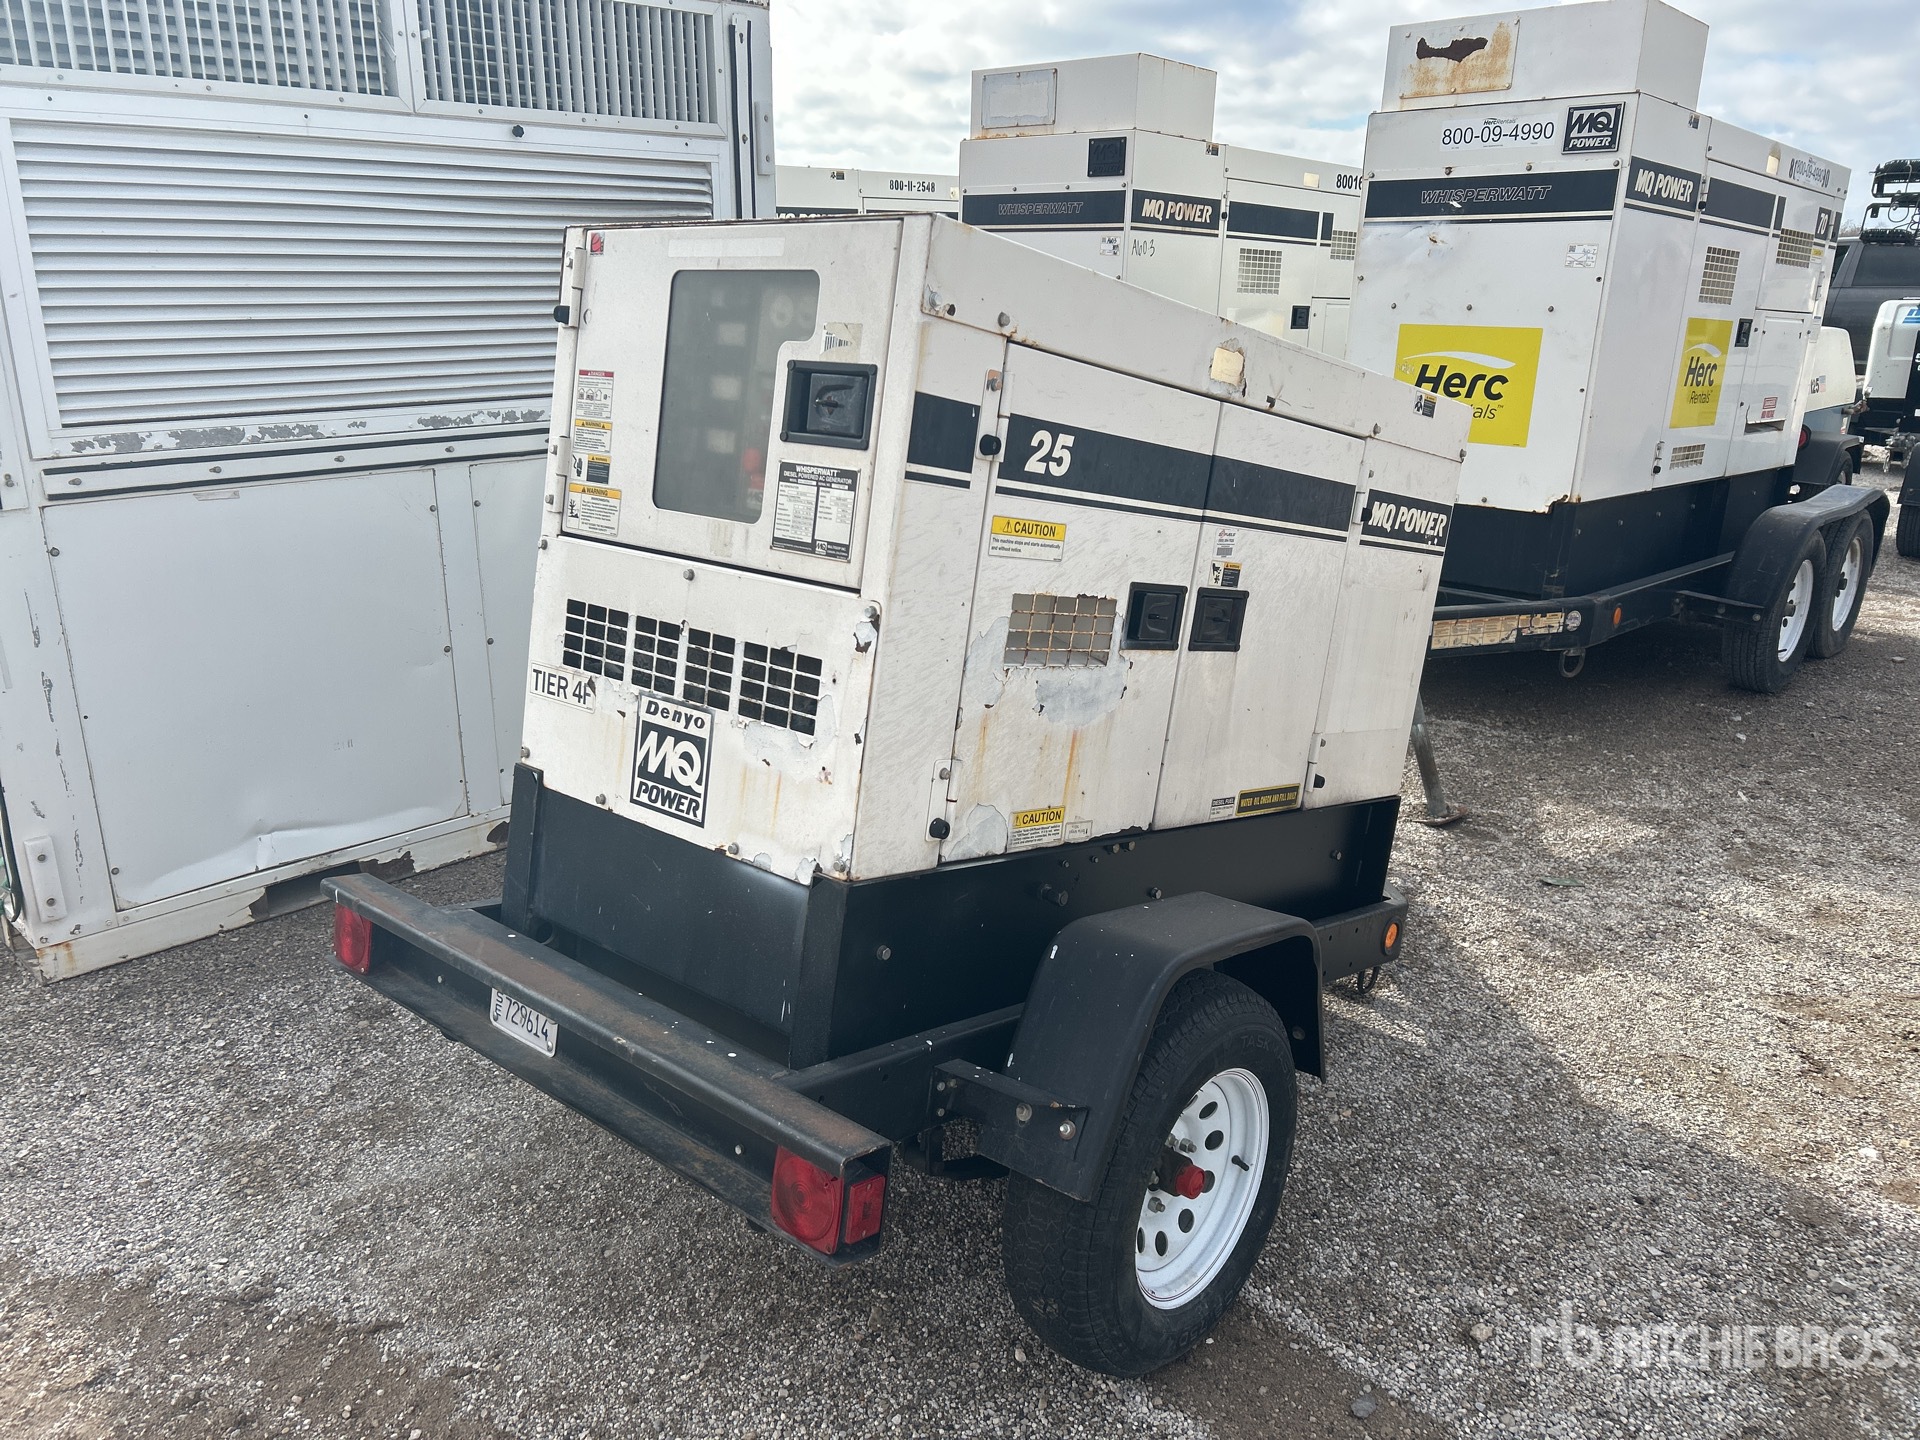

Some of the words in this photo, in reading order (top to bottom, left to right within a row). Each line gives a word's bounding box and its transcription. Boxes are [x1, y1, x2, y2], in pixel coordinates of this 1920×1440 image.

[1442, 122, 1555, 146] 800-09-4990
[1570, 111, 1613, 135] MQ
[1568, 136, 1612, 148] POWER
[1421, 185, 1552, 204] WHISPERWATT
[1634, 168, 1655, 198] MQ
[1653, 173, 1694, 203] POWER
[998, 202, 1084, 215] WHISPERWATT
[1141, 198, 1165, 222] MQ
[1165, 201, 1213, 223] POWER
[1817, 213, 1829, 235] 70
[1415, 364, 1509, 401] Herc
[1684, 356, 1717, 387] Herc
[1024, 429, 1075, 477] 25
[796, 465, 838, 477] WHISPERWATT
[586, 487, 608, 496] WARNING
[1014, 521, 1057, 537] CAUTION
[1368, 501, 1396, 533] MQ
[1394, 506, 1448, 538] POWER
[532, 668, 569, 700] TIER
[645, 700, 706, 730] Denyo
[638, 730, 702, 793] MQ
[635, 780, 700, 818] POWER
[1022, 810, 1062, 825] CAUTION
[505, 996, 549, 1041] 729614
